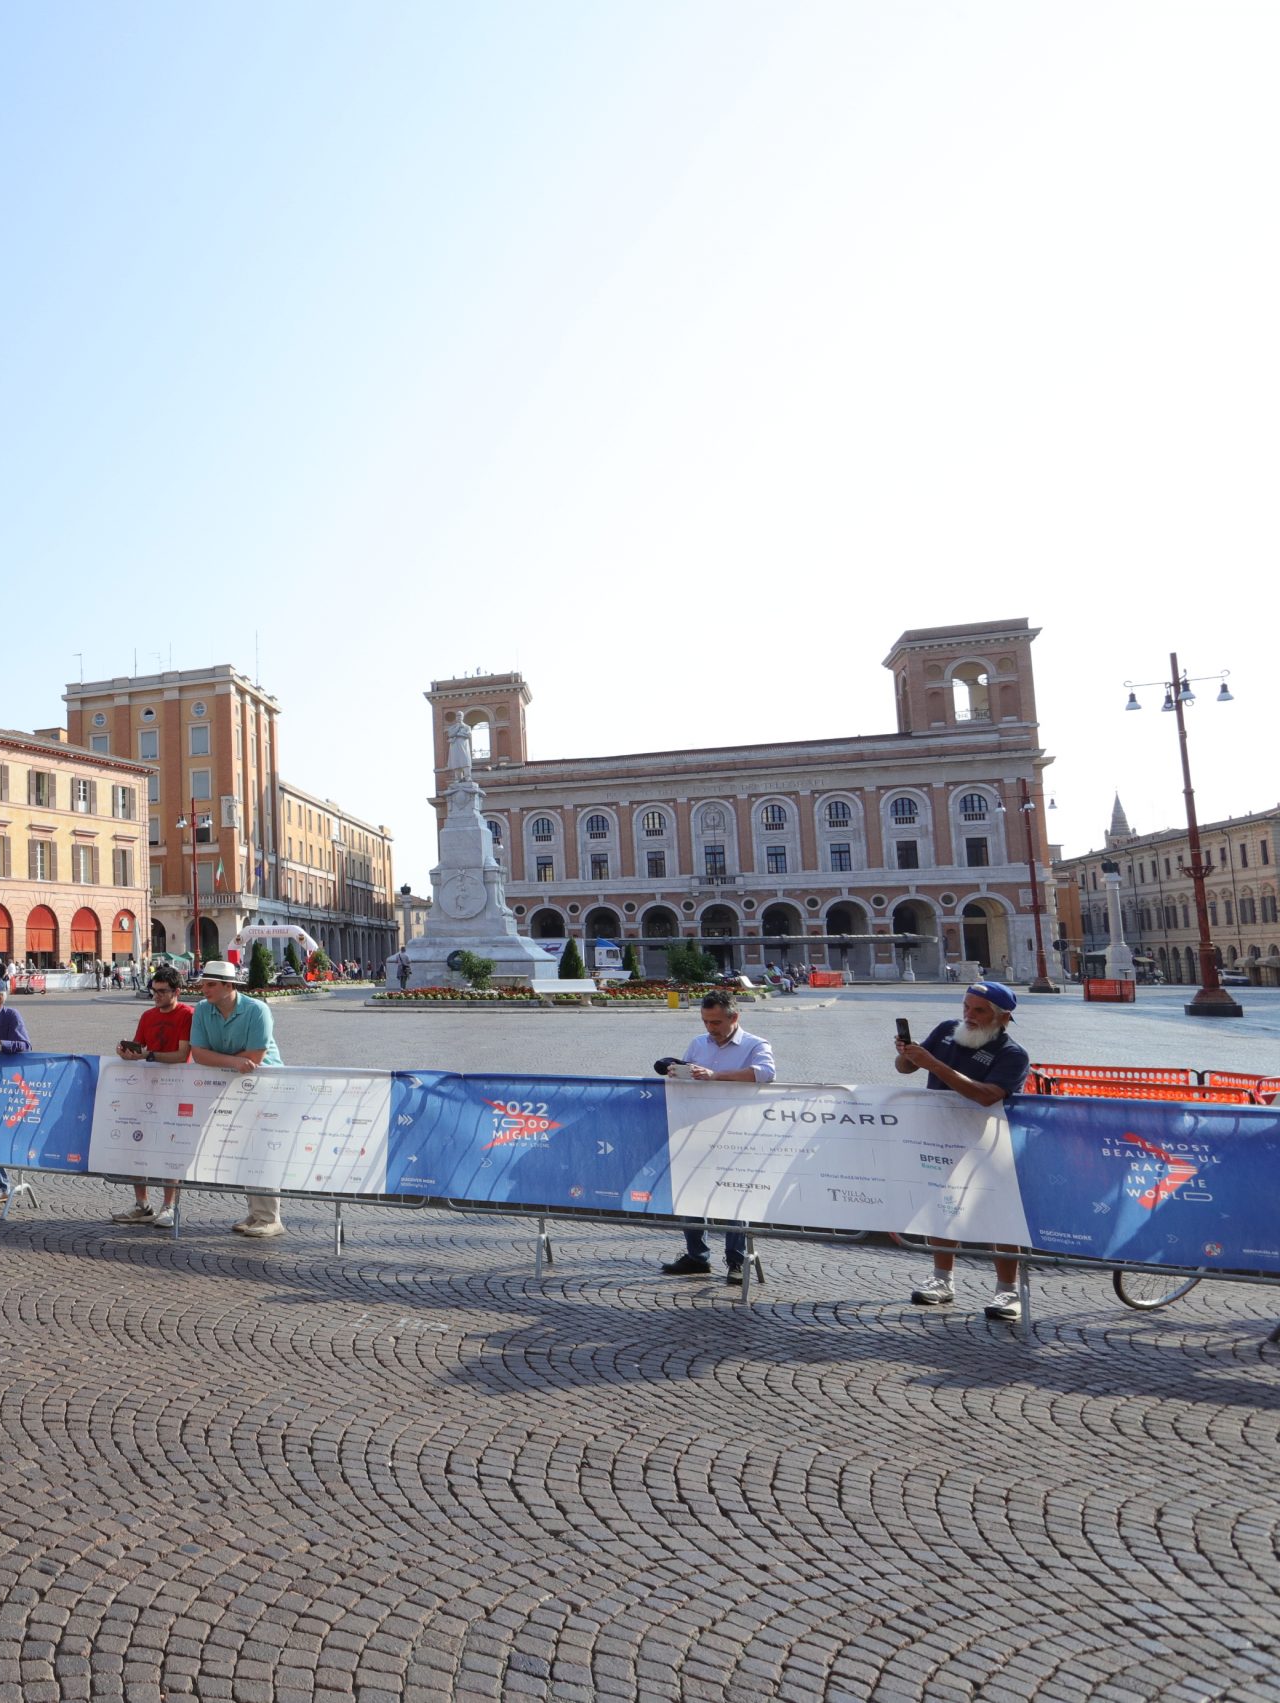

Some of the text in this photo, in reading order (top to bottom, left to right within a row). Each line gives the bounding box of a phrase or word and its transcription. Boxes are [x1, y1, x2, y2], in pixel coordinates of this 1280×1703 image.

[2, 1079, 53, 1089] THE MOST
[8, 1096, 40, 1105] RACE
[492, 1100, 548, 1117] 2022
[492, 1118, 549, 1129] 1000
[762, 1108, 898, 1126] CHOPARD
[492, 1130, 550, 1141] MIGLIA
[1103, 1137, 1211, 1152] THE MOST
[1102, 1148, 1221, 1164] BEAUTIFUL
[1130, 1162, 1199, 1175] RACE
[1127, 1175, 1207, 1188] IN THE
[841, 1189, 867, 1198] VILLA
[1126, 1188, 1213, 1202] WORLD
